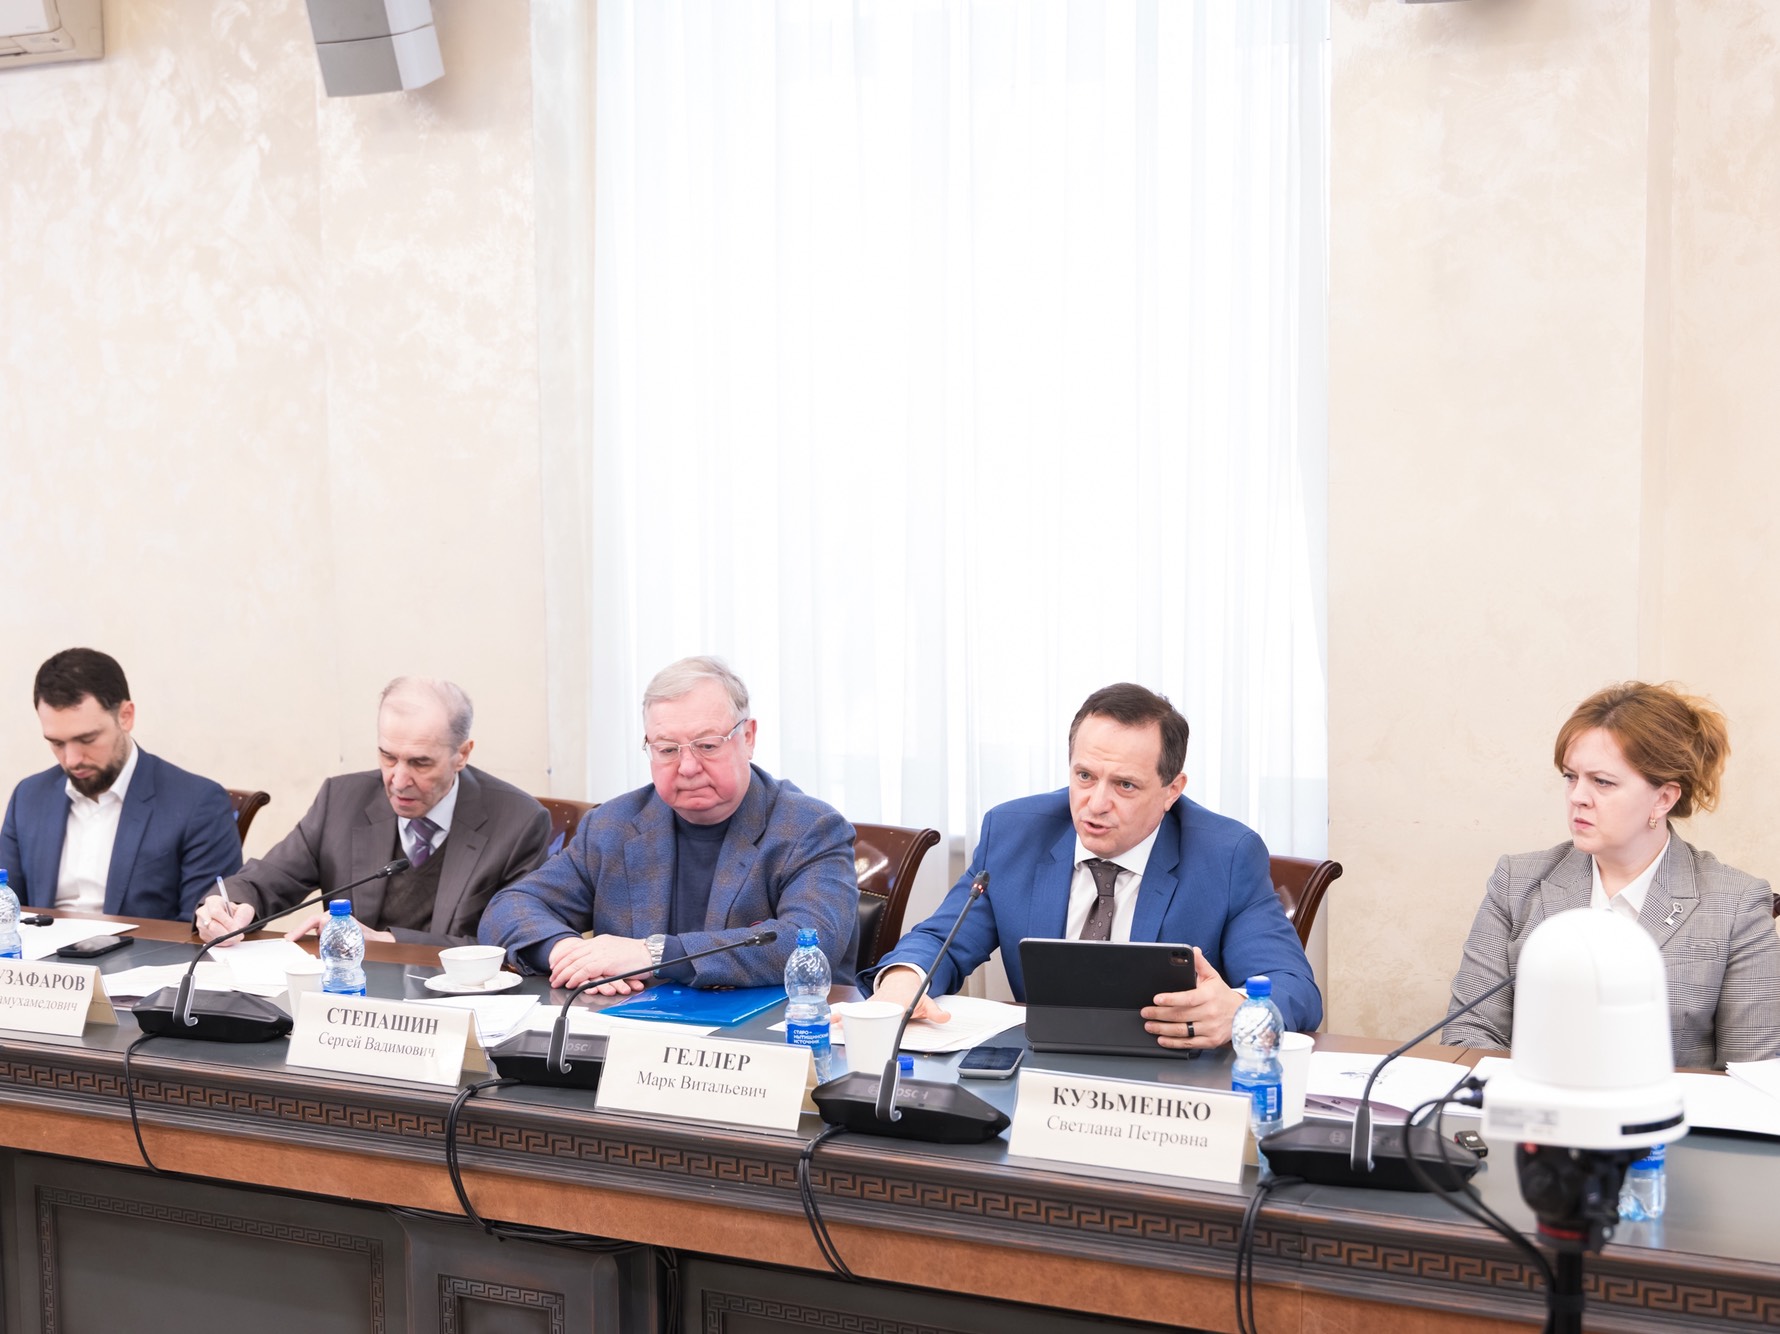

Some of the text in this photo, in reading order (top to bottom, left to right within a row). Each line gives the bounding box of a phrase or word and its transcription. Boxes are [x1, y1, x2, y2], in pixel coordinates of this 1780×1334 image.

[327, 1007, 439, 1034] СТЕПАШИН
[318, 1031, 435, 1058] Сергей Вадимович
[663, 1046, 751, 1071] ГЕЛЛЕР
[636, 1070, 767, 1098] Марк Витальевич
[1052, 1086, 1211, 1121] КУЗЬМЕНКО
[1046, 1114, 1209, 1148] Светлана Петровна
